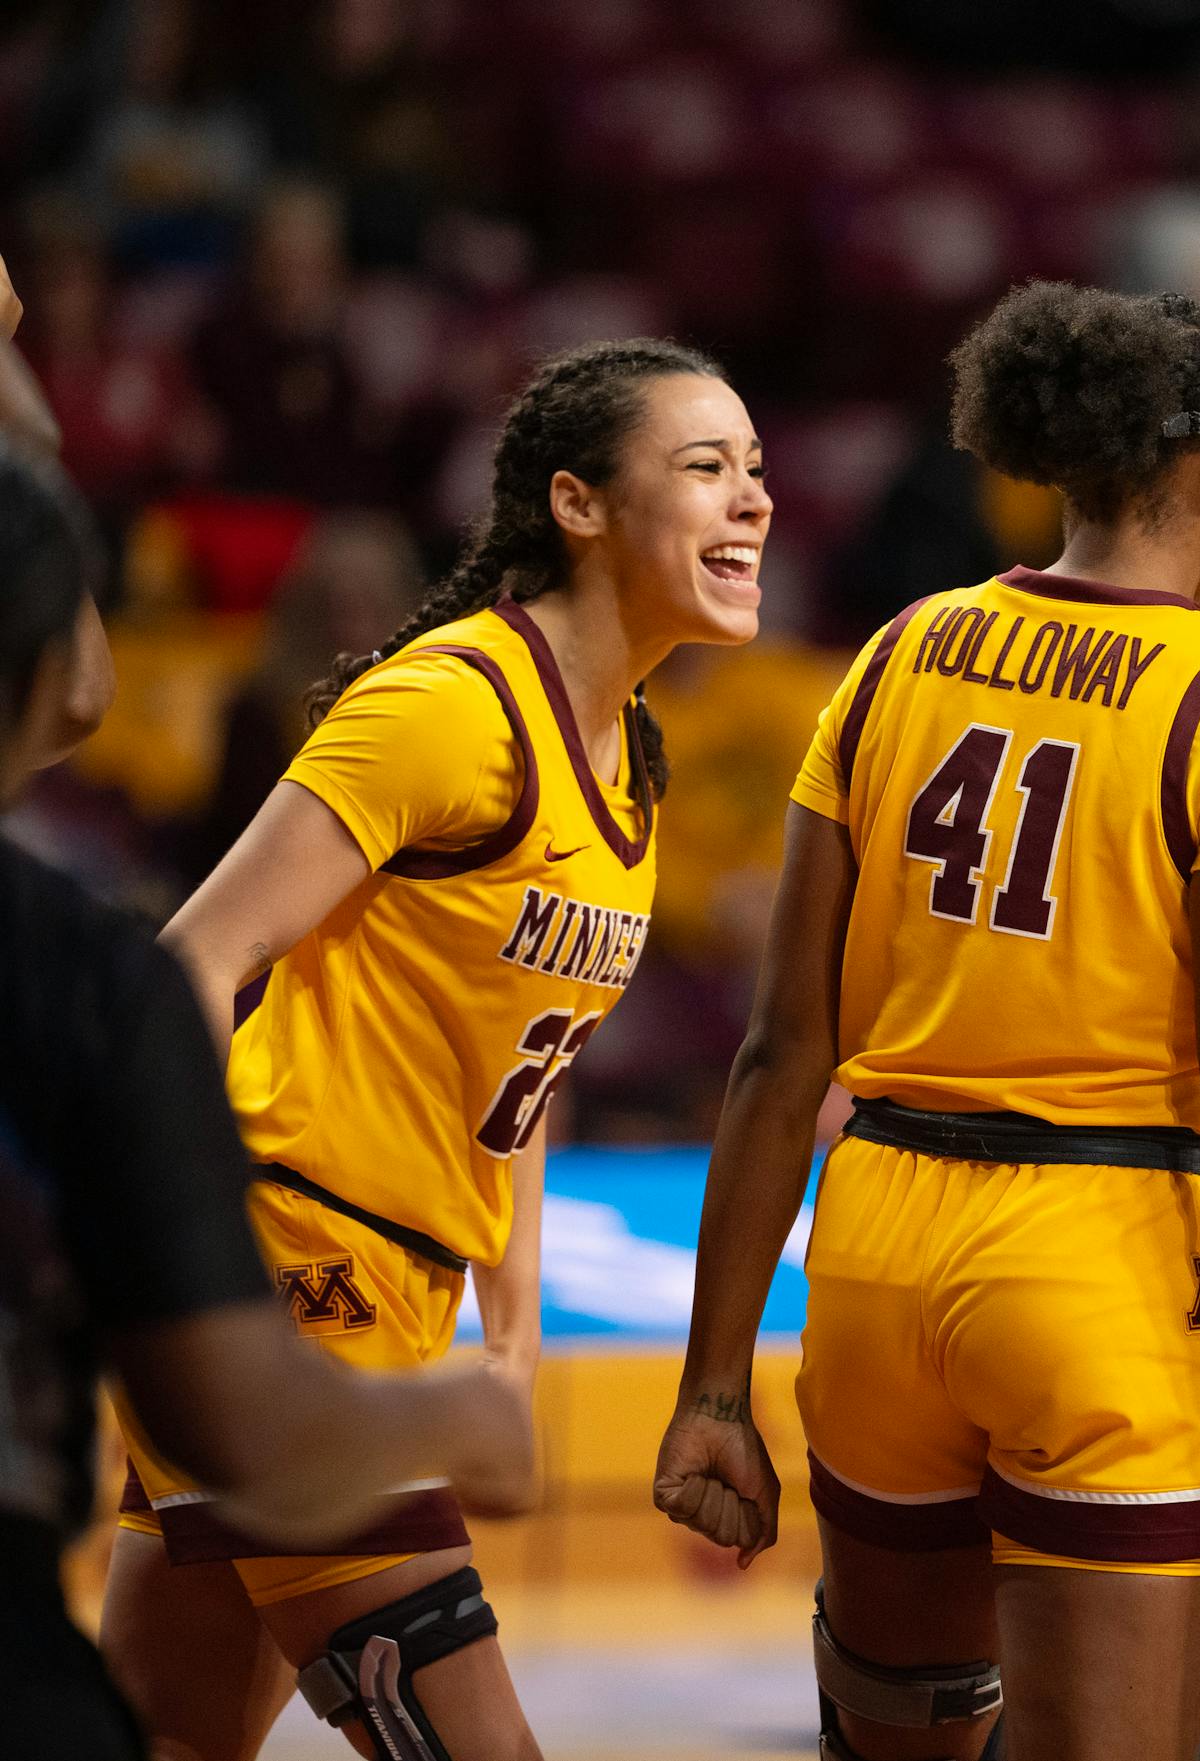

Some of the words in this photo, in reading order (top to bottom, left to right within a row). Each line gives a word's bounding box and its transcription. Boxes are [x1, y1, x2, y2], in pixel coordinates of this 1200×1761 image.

[913, 606, 1166, 710] HOLLOWAY
[904, 722, 1081, 941] 41
[497, 884, 651, 990] MINNES
[274, 1255, 377, 1330] M
